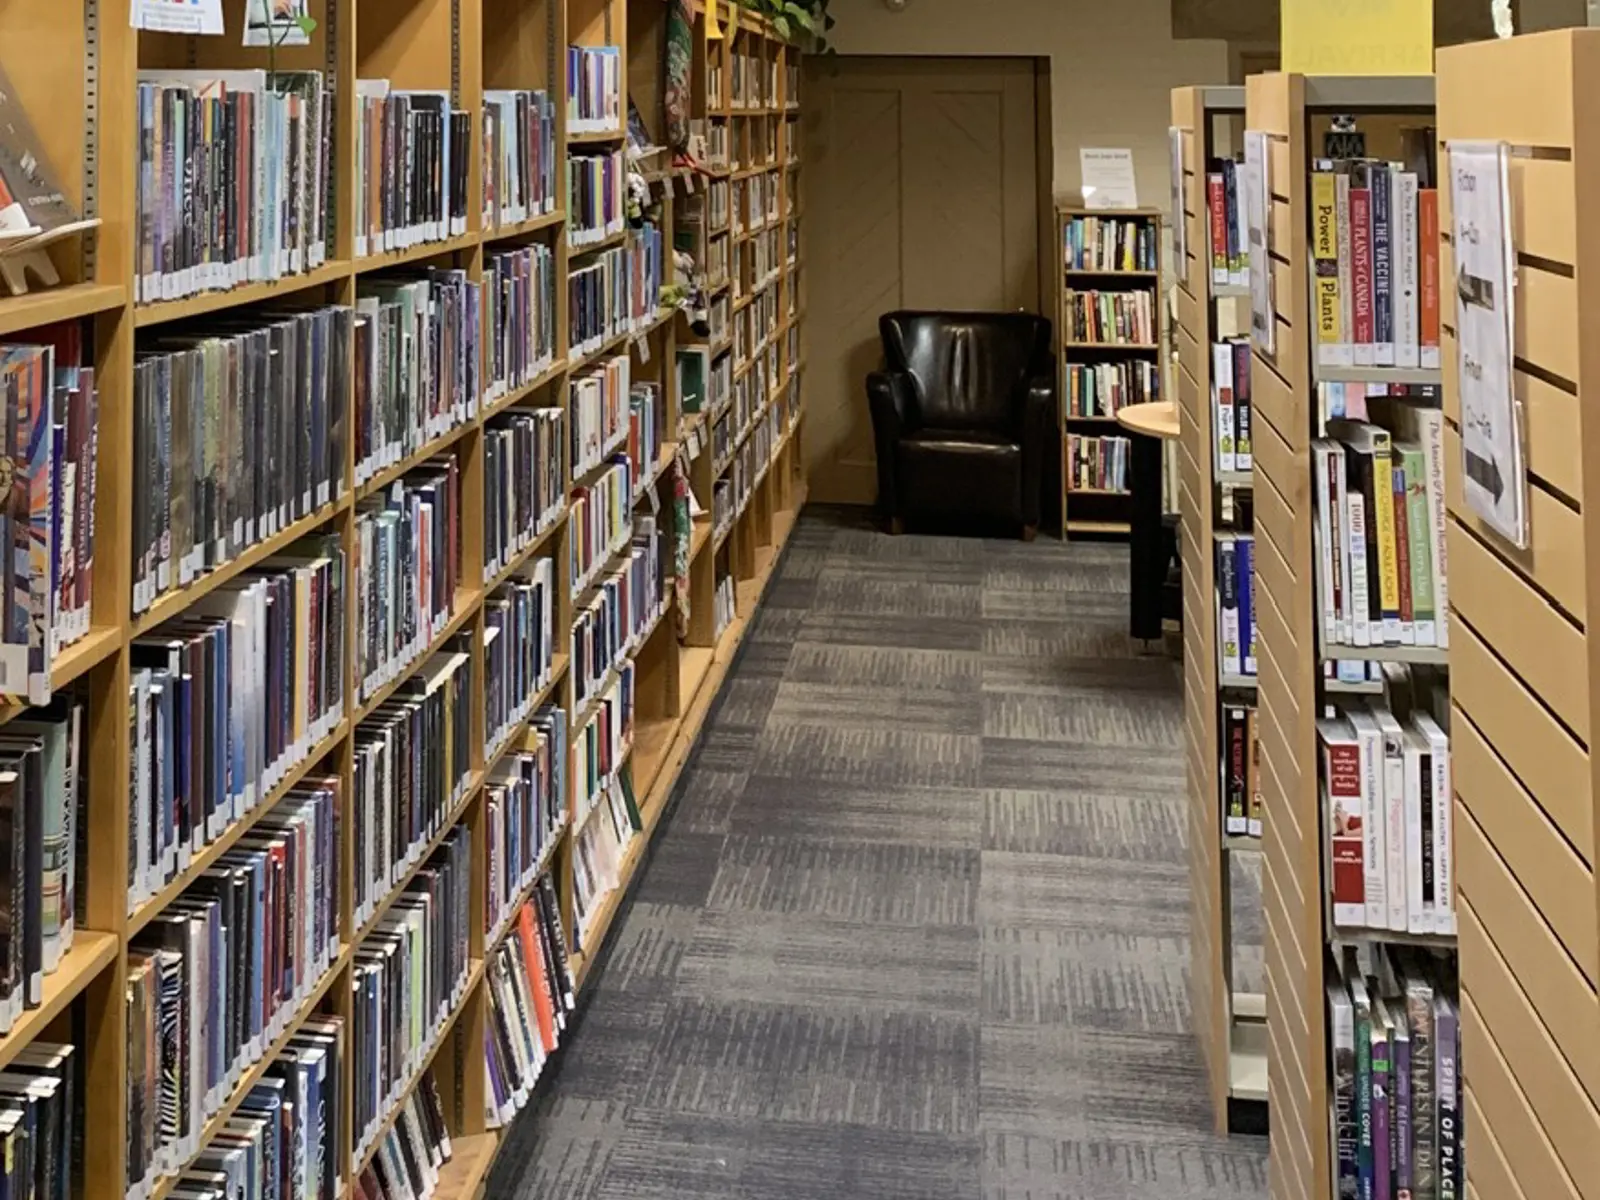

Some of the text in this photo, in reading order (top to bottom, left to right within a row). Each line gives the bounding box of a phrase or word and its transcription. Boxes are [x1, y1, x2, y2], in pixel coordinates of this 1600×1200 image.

[1318, 204, 1333, 254] Power
[1354, 227, 1366, 265] PLANTS
[1375, 222, 1388, 248] THE
[1376, 250, 1389, 295] VACCINE
[1321, 281, 1335, 332] Plants
[1355, 275, 1369, 317] CANADA
[1361, 1074, 1370, 1110] UNDER
[1362, 1113, 1371, 1147] COVER
[1441, 1057, 1454, 1199] SPIRIT OF PLACE
